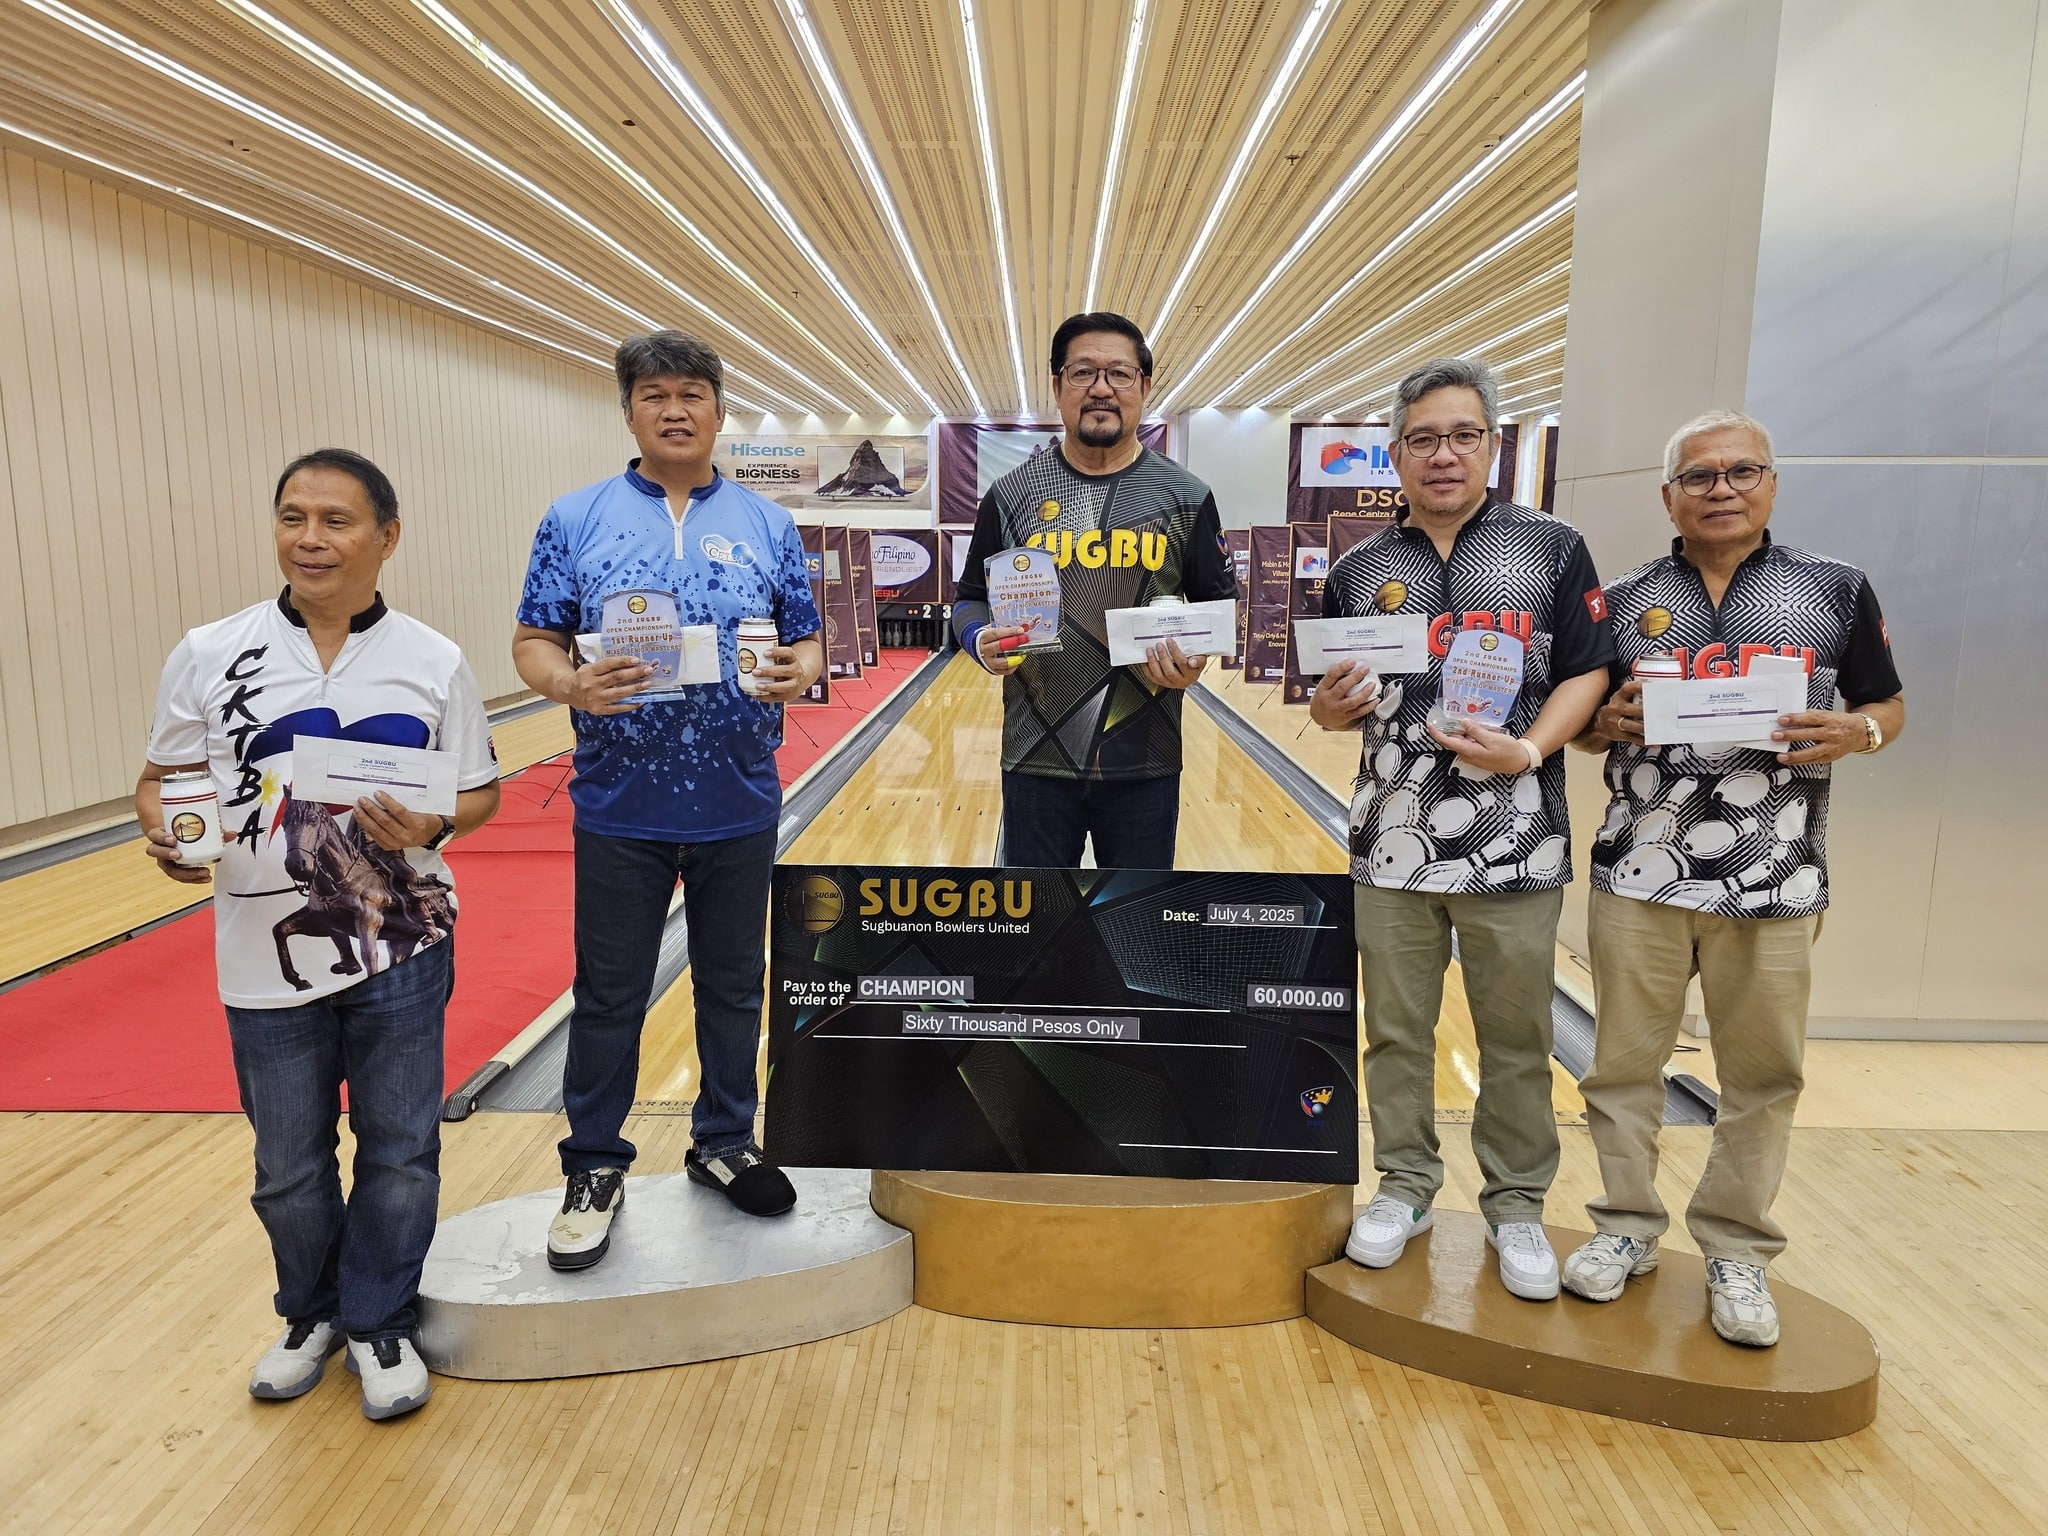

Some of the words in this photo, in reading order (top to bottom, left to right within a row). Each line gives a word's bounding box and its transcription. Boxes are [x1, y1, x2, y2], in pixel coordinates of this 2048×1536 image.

[731, 443, 806, 457] Hisense
[735, 468, 801, 479] BIGNESS
[873, 565, 924, 573] RIENDLIEST
[1010, 580, 1054, 589] CHAMPIONSHIPS
[875, 589, 900, 598] EBU
[1000, 590, 1051, 601] Champion
[922, 604, 931, 619] 2
[942, 604, 952, 619] 3
[623, 624, 673, 633] CHAMPIONSHIPS
[611, 636, 625, 645] 1st
[1465, 650, 1480, 659] 2nd
[1452, 657, 1468, 665] OPEN
[1469, 660, 1518, 673] CHAMPIONSHIPS
[1452, 665, 1468, 676] 2nd
[814, 891, 840, 899] SUGBU
[860, 878, 1032, 919] SUGBU
[1163, 909, 1200, 922] Date:
[1209, 907, 1239, 924] July
[1241, 908, 1255, 923] 4,
[1259, 908, 1295, 922] 2025
[861, 920, 931, 934] Sugbuanon
[936, 920, 985, 934] Bowlers
[988, 921, 1030, 934] United
[783, 980, 808, 995] Pay
[811, 982, 825, 993] to
[829, 980, 852, 993] the
[860, 979, 965, 996] CHAMPION
[789, 993, 827, 1006] order
[830, 993, 845, 1006] of
[1254, 987, 1345, 1008] 60,000.00
[905, 1014, 944, 1033] Sixty
[949, 1015, 1027, 1033] Thousand
[1032, 1018, 1082, 1034] Pesos
[1086, 1019, 1124, 1039] Only
